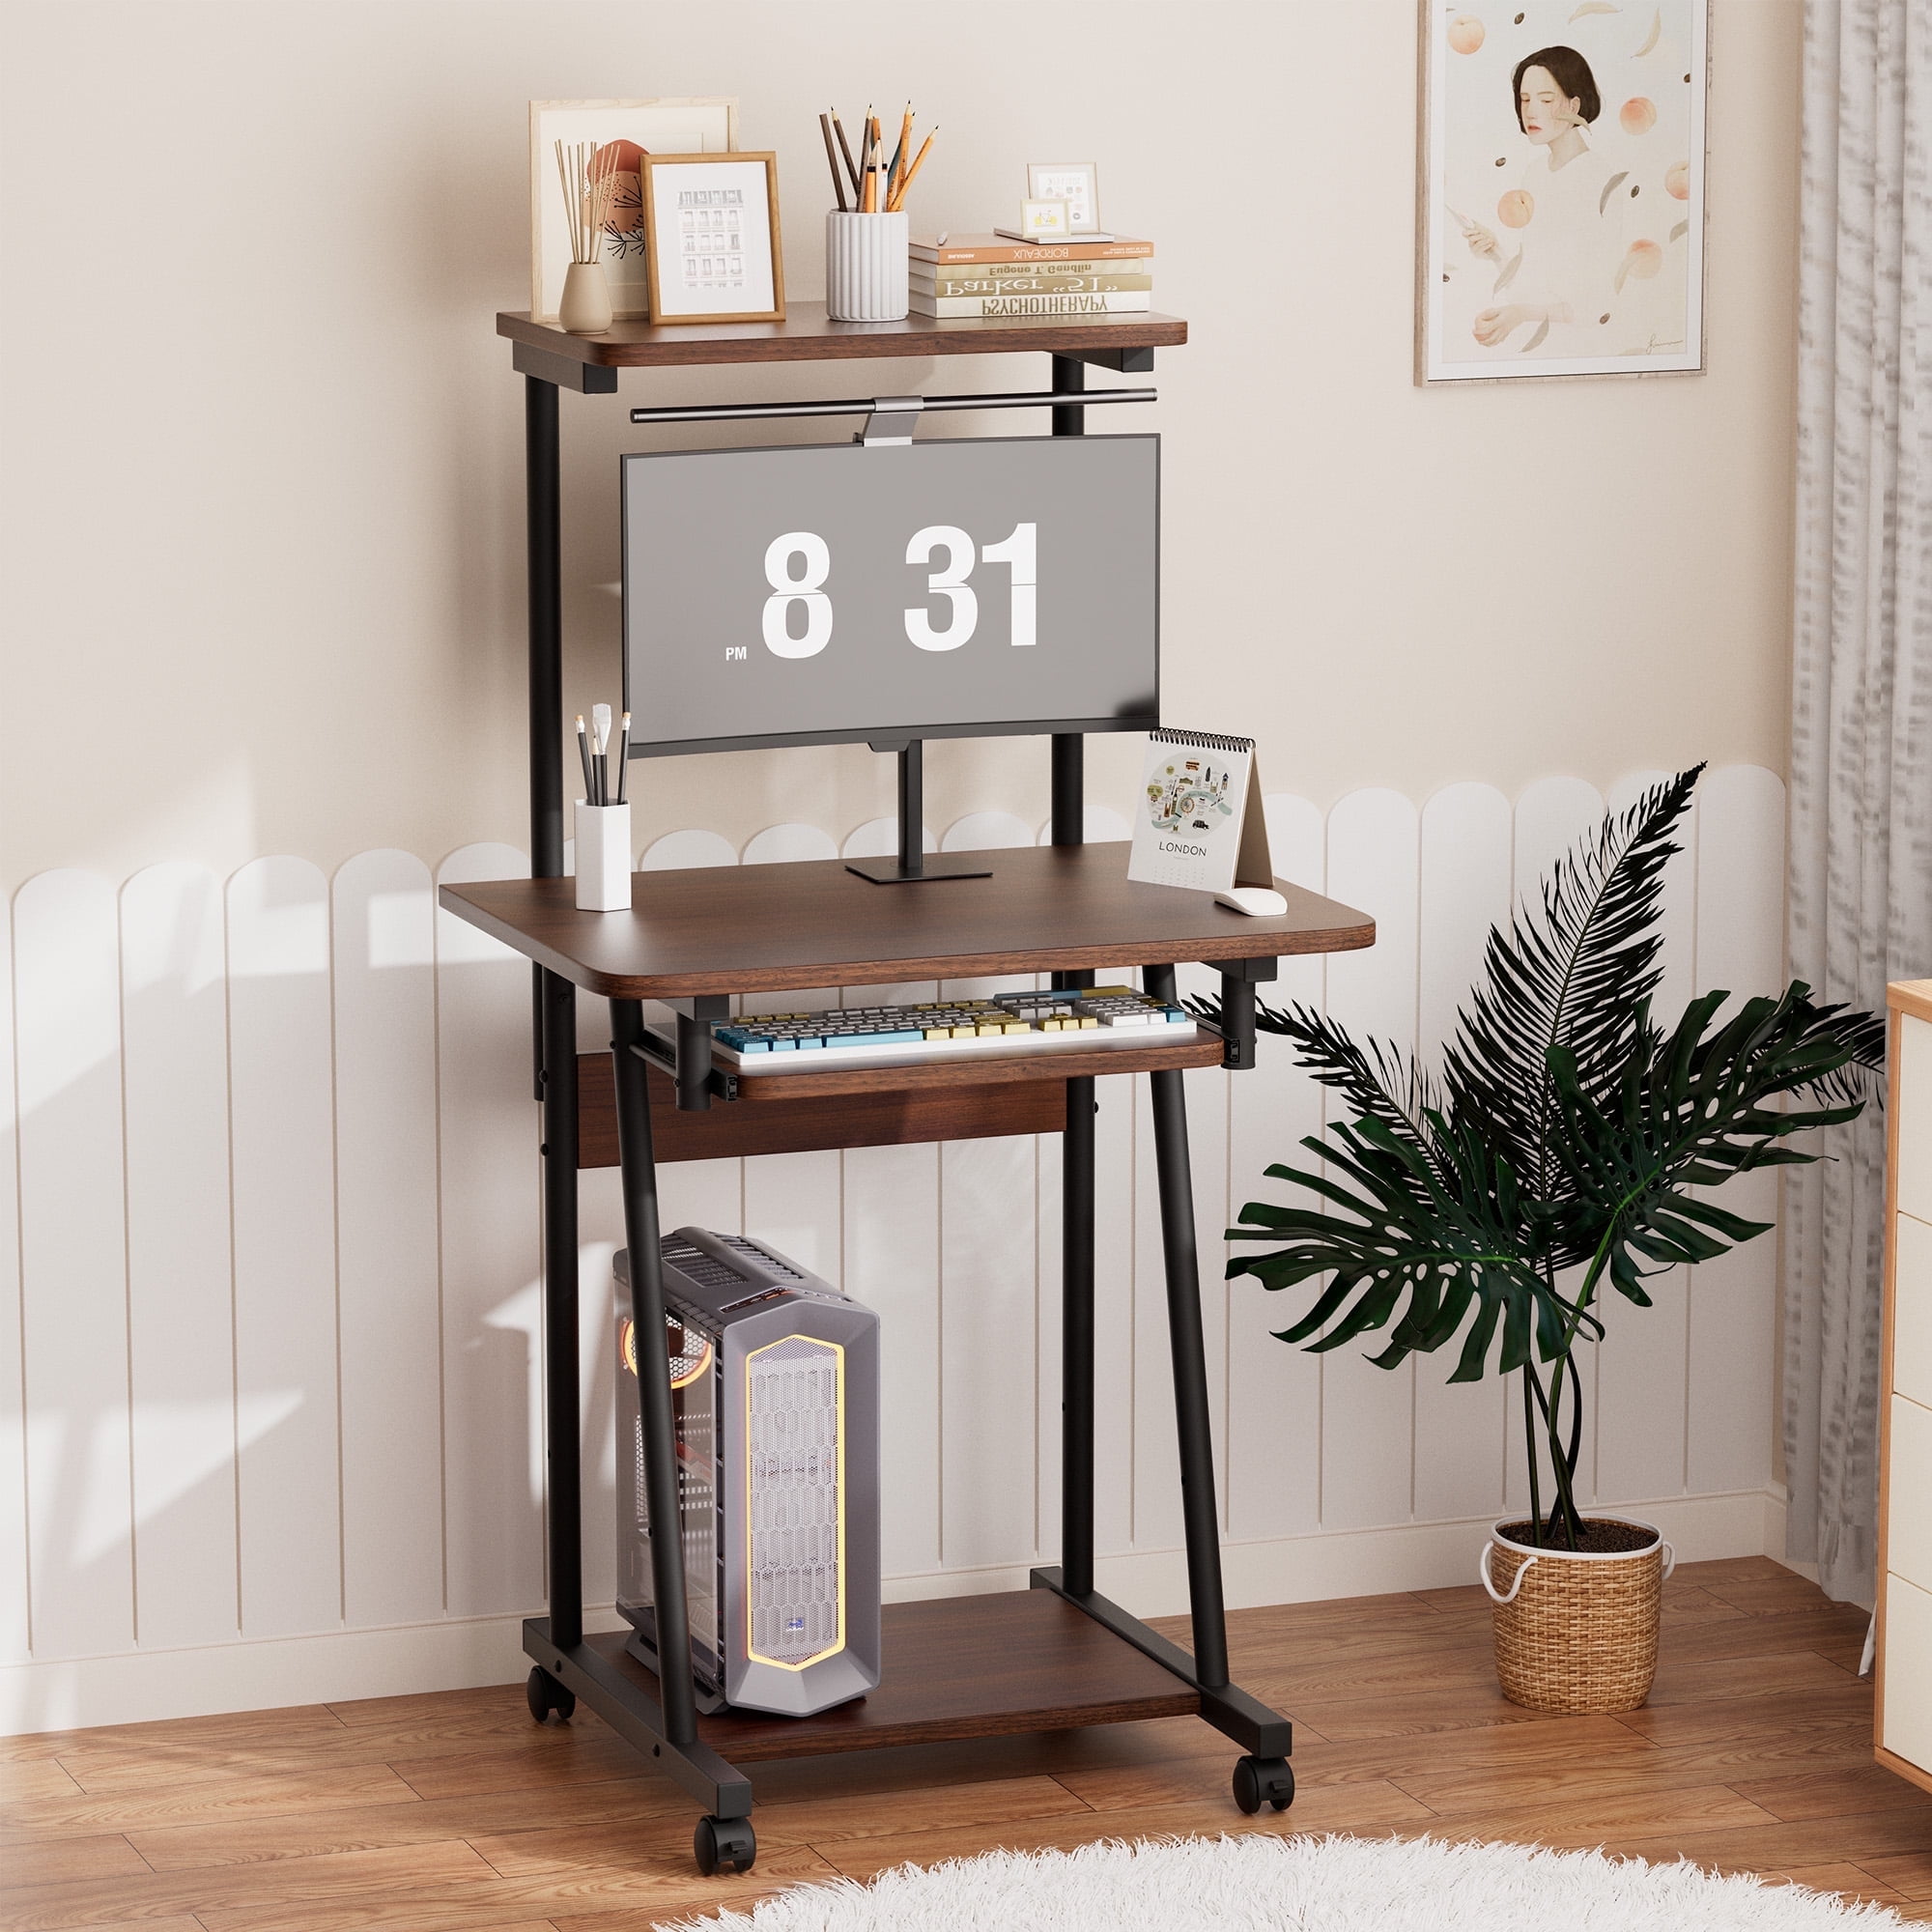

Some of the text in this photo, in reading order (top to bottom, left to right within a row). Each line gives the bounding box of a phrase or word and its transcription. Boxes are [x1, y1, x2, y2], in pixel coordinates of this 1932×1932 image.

[1013, 247, 1068, 260] BORDEAUX
[761, 522, 1037, 660] 8 31
[725, 646, 748, 662] PM
[1159, 841, 1208, 857] LONDON
